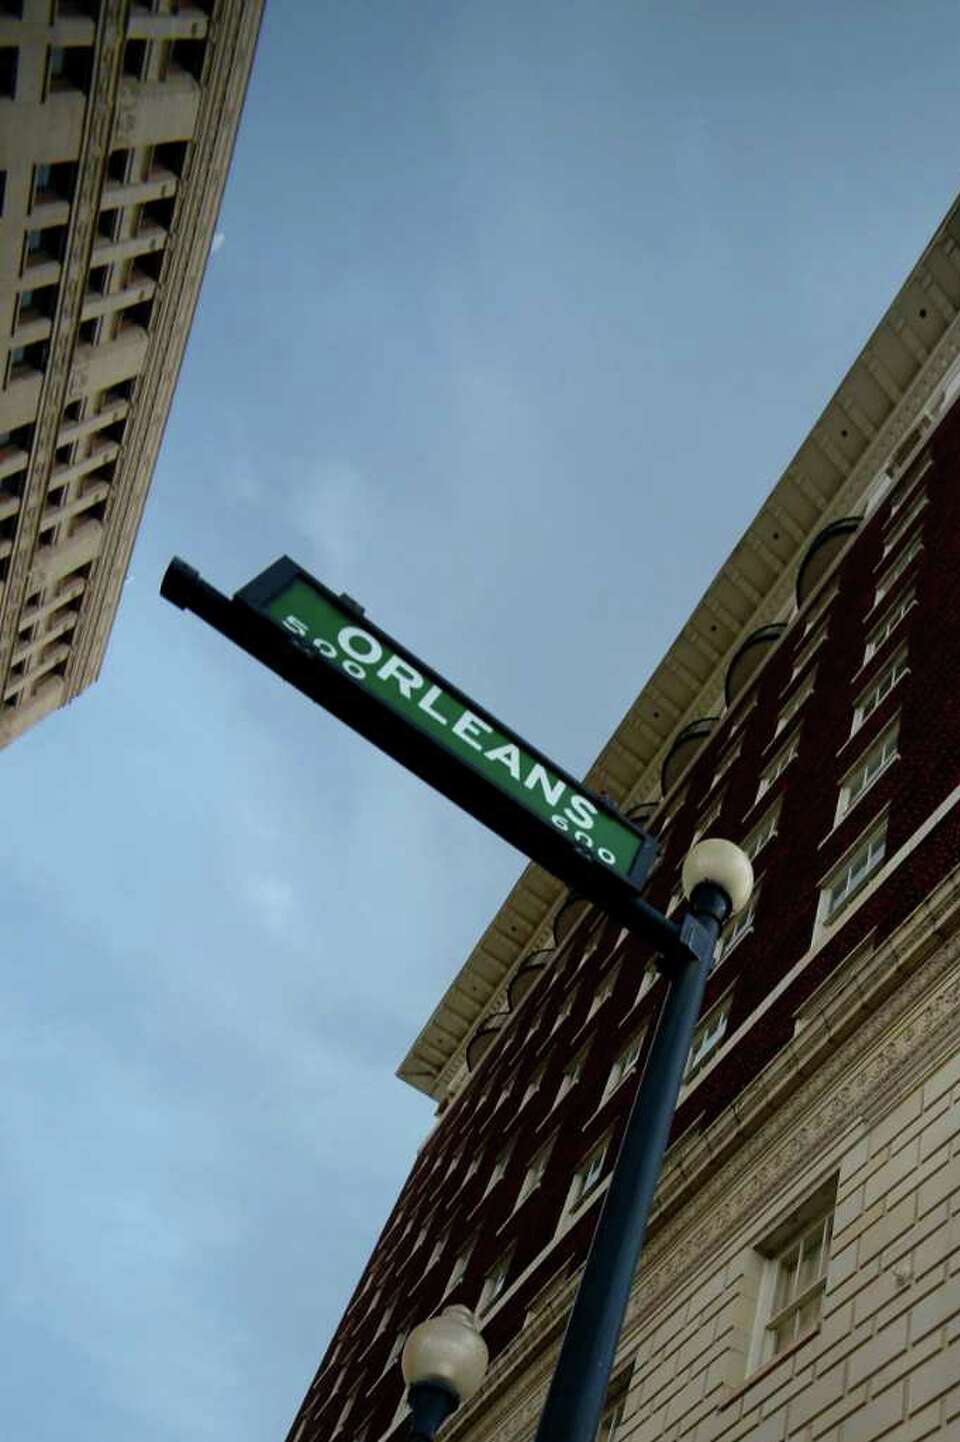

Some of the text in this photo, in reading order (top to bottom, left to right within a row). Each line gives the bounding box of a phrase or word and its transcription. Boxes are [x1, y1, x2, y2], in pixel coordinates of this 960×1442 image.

[282, 614, 367, 680] 500
[337, 625, 598, 830] ORLEANS
[551, 814, 617, 866] 600
